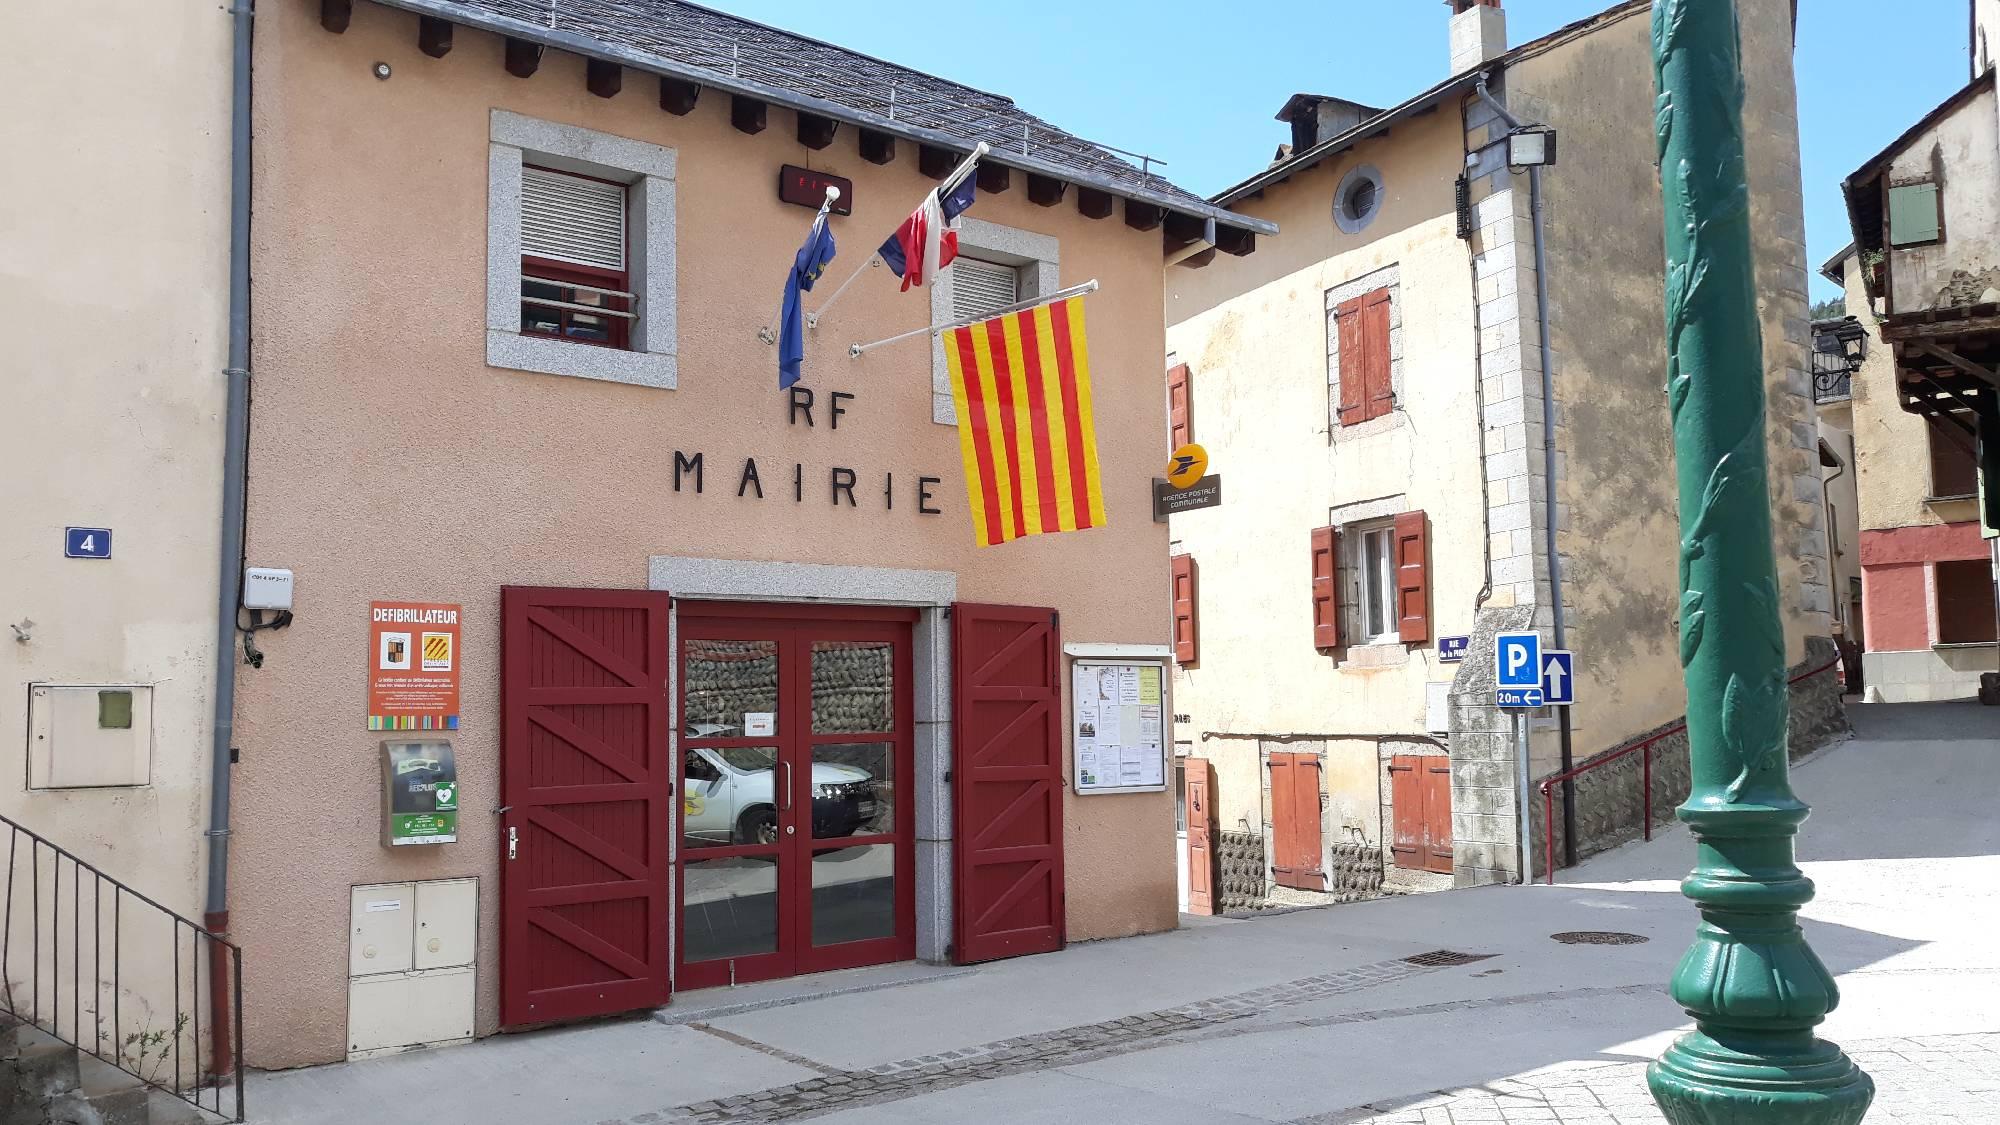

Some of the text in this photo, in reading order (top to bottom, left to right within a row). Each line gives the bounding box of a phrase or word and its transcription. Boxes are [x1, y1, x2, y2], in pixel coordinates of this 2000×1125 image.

[790, 386, 854, 429] RF
[674, 450, 941, 514] MAIRIE
[1162, 487, 1217, 502] AGENCE POSTALE
[1170, 496, 1209, 508] COMMUNALE
[80, 534, 94, 552] 4
[373, 607, 457, 625] DEFIBRILLATEUR
[1507, 643, 1528, 677] P
[1498, 692, 1521, 704] 20m
